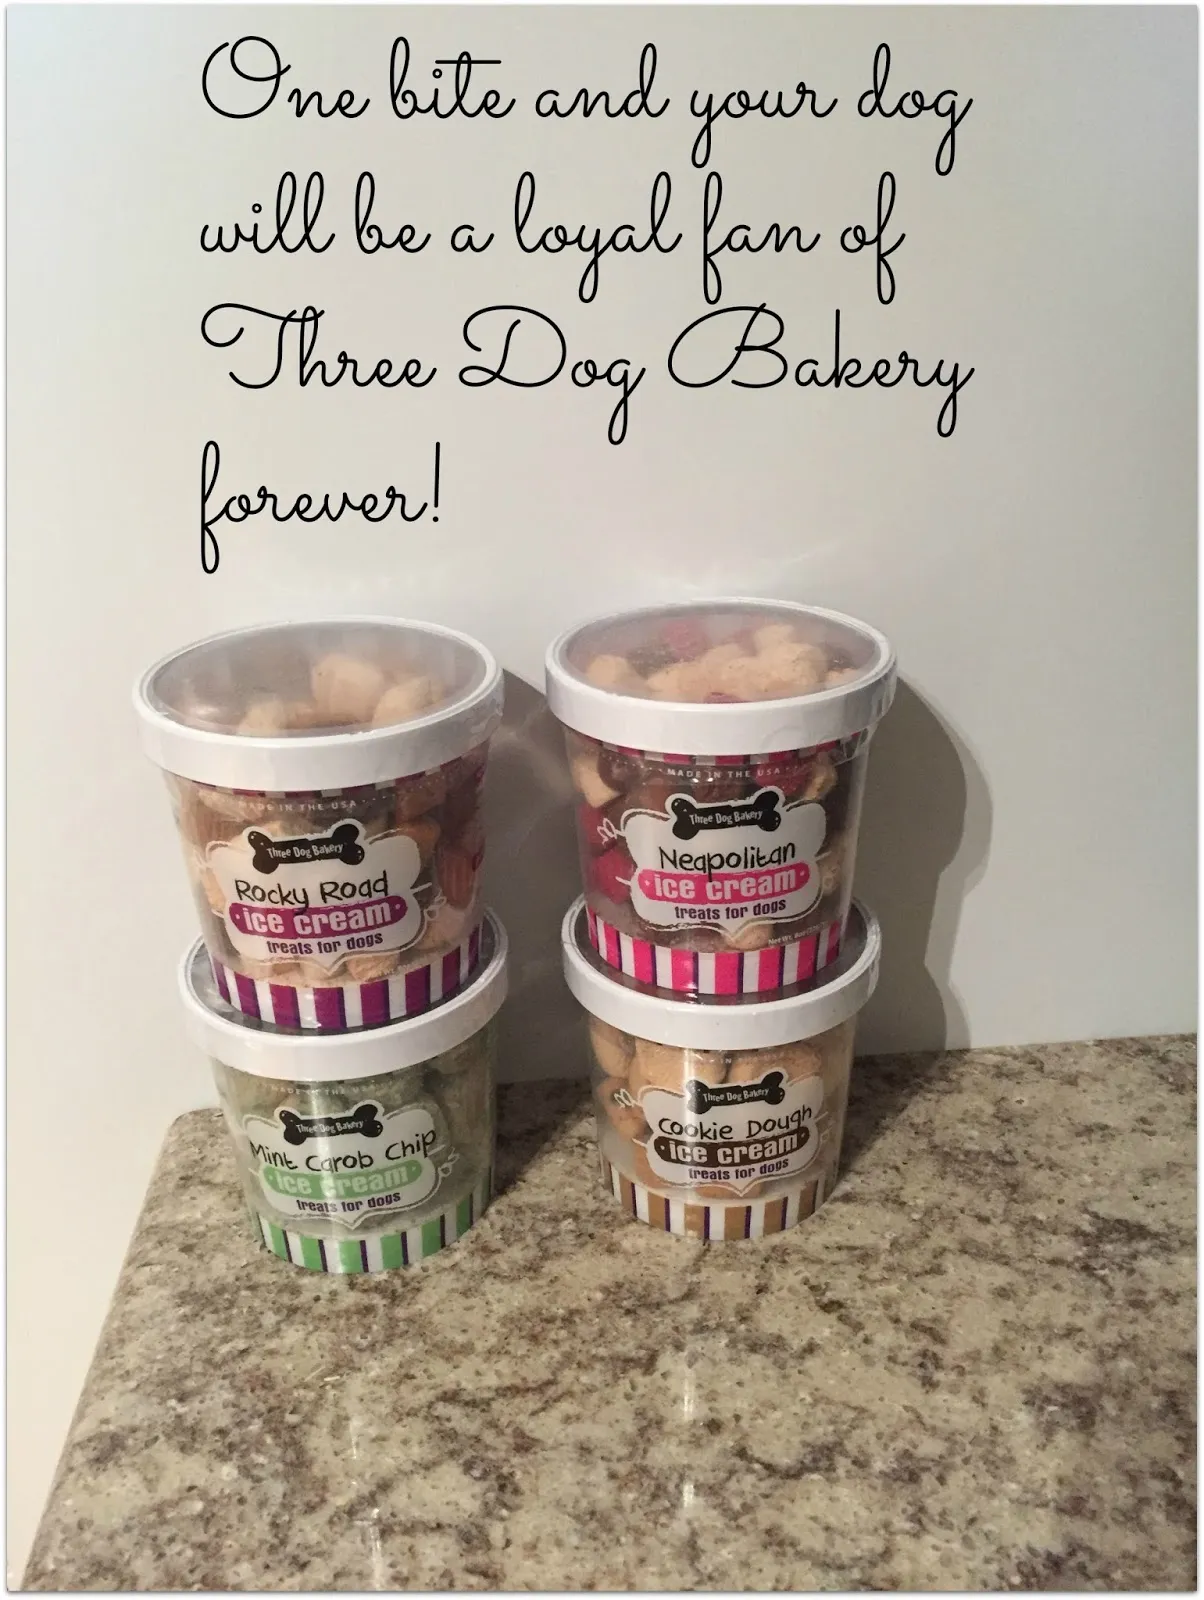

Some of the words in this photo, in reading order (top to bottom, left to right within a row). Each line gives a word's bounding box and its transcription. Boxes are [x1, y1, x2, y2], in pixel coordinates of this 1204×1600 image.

[667, 768, 701, 778] MADE
[708, 771, 722, 779] IN
[727, 770, 751, 778] THE
[757, 767, 781, 777] USA
[300, 803, 325, 811] THE
[331, 800, 357, 810] USA
[689, 813, 713, 825] Three
[715, 812, 733, 824] Dog
[734, 809, 763, 823] Bakery
[266, 846, 291, 859] Three
[292, 846, 312, 859] Dog
[312, 843, 344, 856] Bakery
[658, 842, 796, 882] Neapolitan
[235, 879, 310, 916] Rocky
[319, 870, 390, 904] Road
[654, 874, 696, 899] ice
[706, 868, 797, 900] cream
[243, 907, 285, 934] ice
[293, 901, 392, 935] cream
[674, 906, 720, 920] treats
[725, 905, 748, 919] for
[752, 899, 787, 916] dogs
[266, 940, 312, 955] treats
[317, 940, 341, 954] for
[346, 932, 384, 951] dogs
[703, 1092, 725, 1102] Three
[726, 1091, 742, 1102] Dog
[743, 1087, 770, 1100] Bakery
[296, 1123, 318, 1134] Three
[319, 1122, 336, 1134] Dog
[336, 1119, 364, 1132] Bakery
[658, 1117, 733, 1141] Cookie
[745, 1104, 812, 1139] Dough
[249, 1140, 298, 1170] Mint
[305, 1151, 374, 1174] Carob
[385, 1130, 437, 1158] Chip
[669, 1140, 708, 1164] ice
[717, 1134, 798, 1165] cream
[688, 1168, 730, 1181] treats
[735, 1167, 756, 1180] for
[760, 1158, 789, 1176] dogs
[275, 1169, 312, 1194] ice
[320, 1166, 409, 1198] cream
[296, 1199, 338, 1213] treats
[341, 1199, 363, 1213] for
[367, 1192, 401, 1208] dogs
